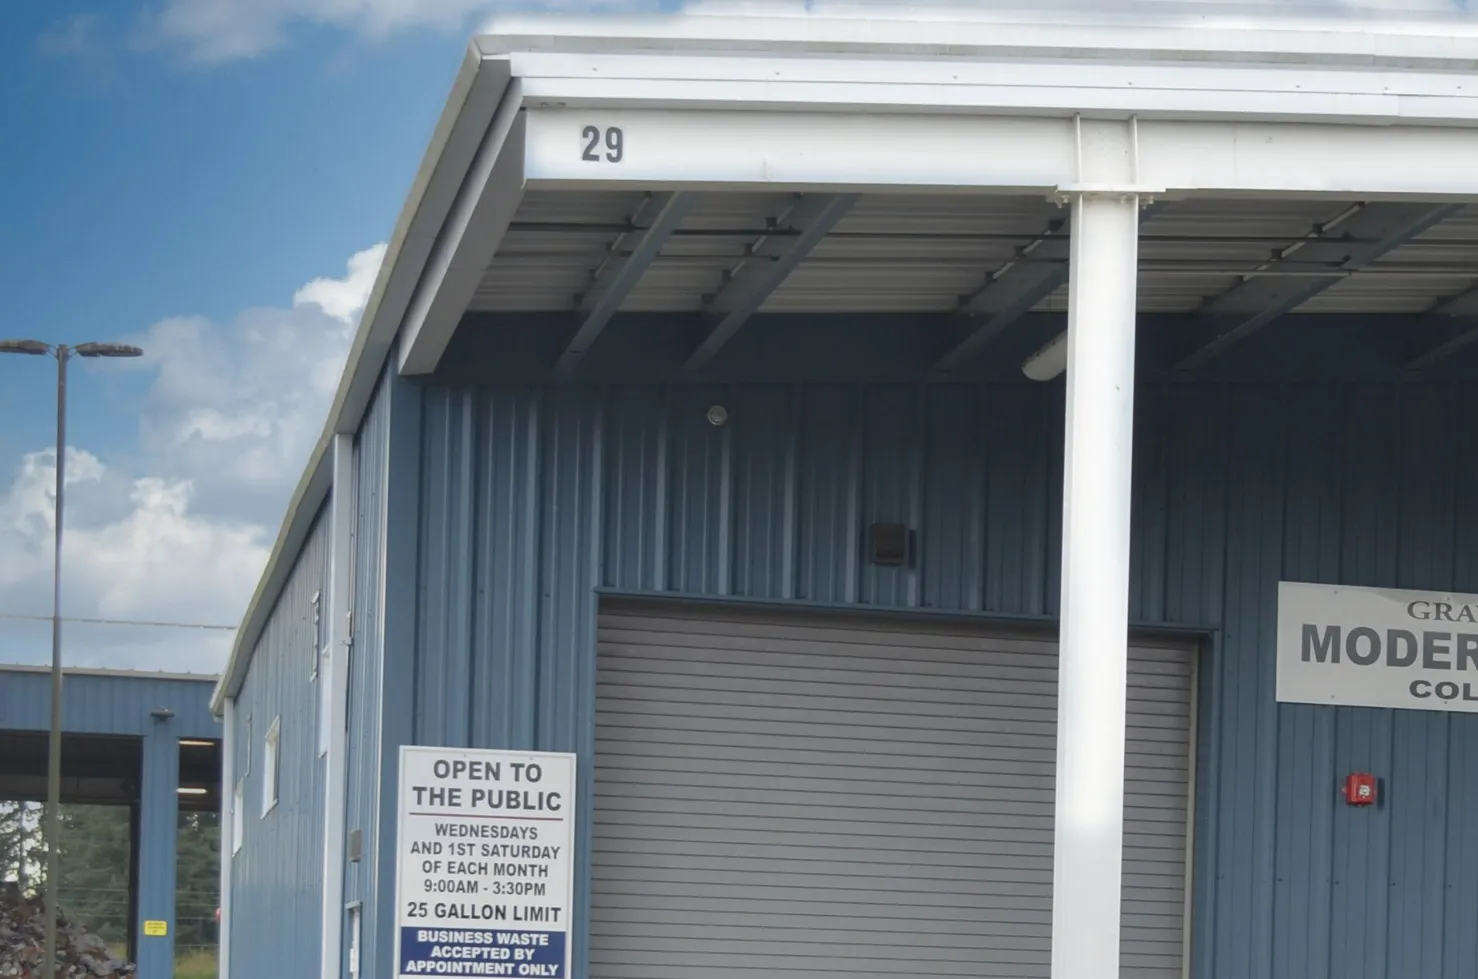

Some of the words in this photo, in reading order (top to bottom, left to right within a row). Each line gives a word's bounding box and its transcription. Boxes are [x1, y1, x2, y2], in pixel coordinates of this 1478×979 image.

[582, 125, 623, 163] 29
[433, 760, 501, 781] OPEN
[510, 763, 542, 782] TO
[412, 787, 462, 807] THE
[471, 790, 562, 811] PUBLIC
[435, 823, 538, 840] WEDNESDAYS
[411, 841, 442, 855] AND
[448, 843, 476, 857] 1ST
[481, 844, 560, 859] SATURDAY
[422, 861, 442, 874] OF
[447, 862, 489, 875] EACH
[494, 864, 549, 877] MONTH
[424, 879, 478, 894] 9:00AM
[493, 882, 546, 896] 3:30PM
[407, 902, 428, 917] 25
[435, 904, 507, 920] GALLON
[513, 906, 562, 922] LIMIT
[417, 930, 493, 944] BUSINESS
[497, 932, 549, 946] WASTE
[431, 945, 510, 959] ACCEPTED
[514, 949, 536, 960] BY
[405, 961, 515, 974] APPOINTMENT
[519, 964, 559, 976] ONLY
